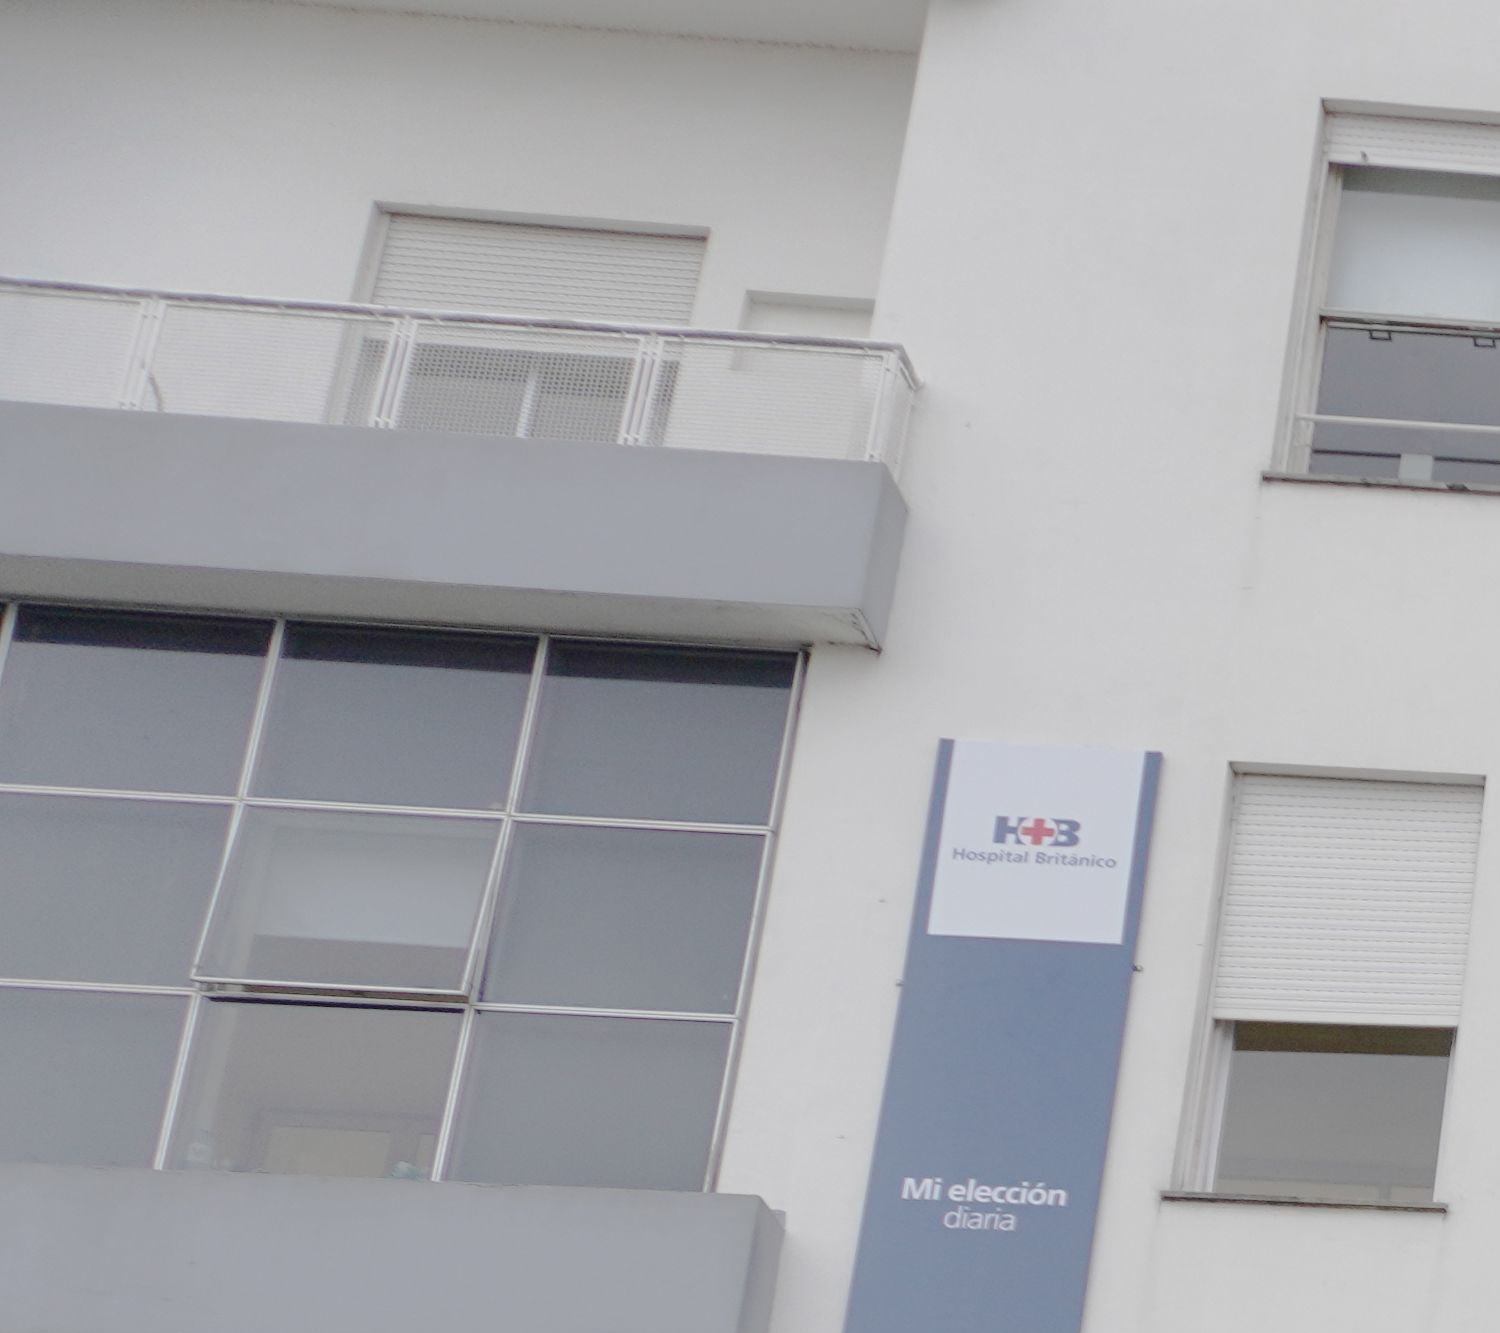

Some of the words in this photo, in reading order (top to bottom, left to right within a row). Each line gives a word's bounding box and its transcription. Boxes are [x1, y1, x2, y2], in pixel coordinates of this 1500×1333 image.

[952, 848, 1029, 866] Hospital
[901, 1177, 944, 1201] Mi
[948, 1178, 1068, 1207] elección
[943, 1205, 1017, 1232] diaria
